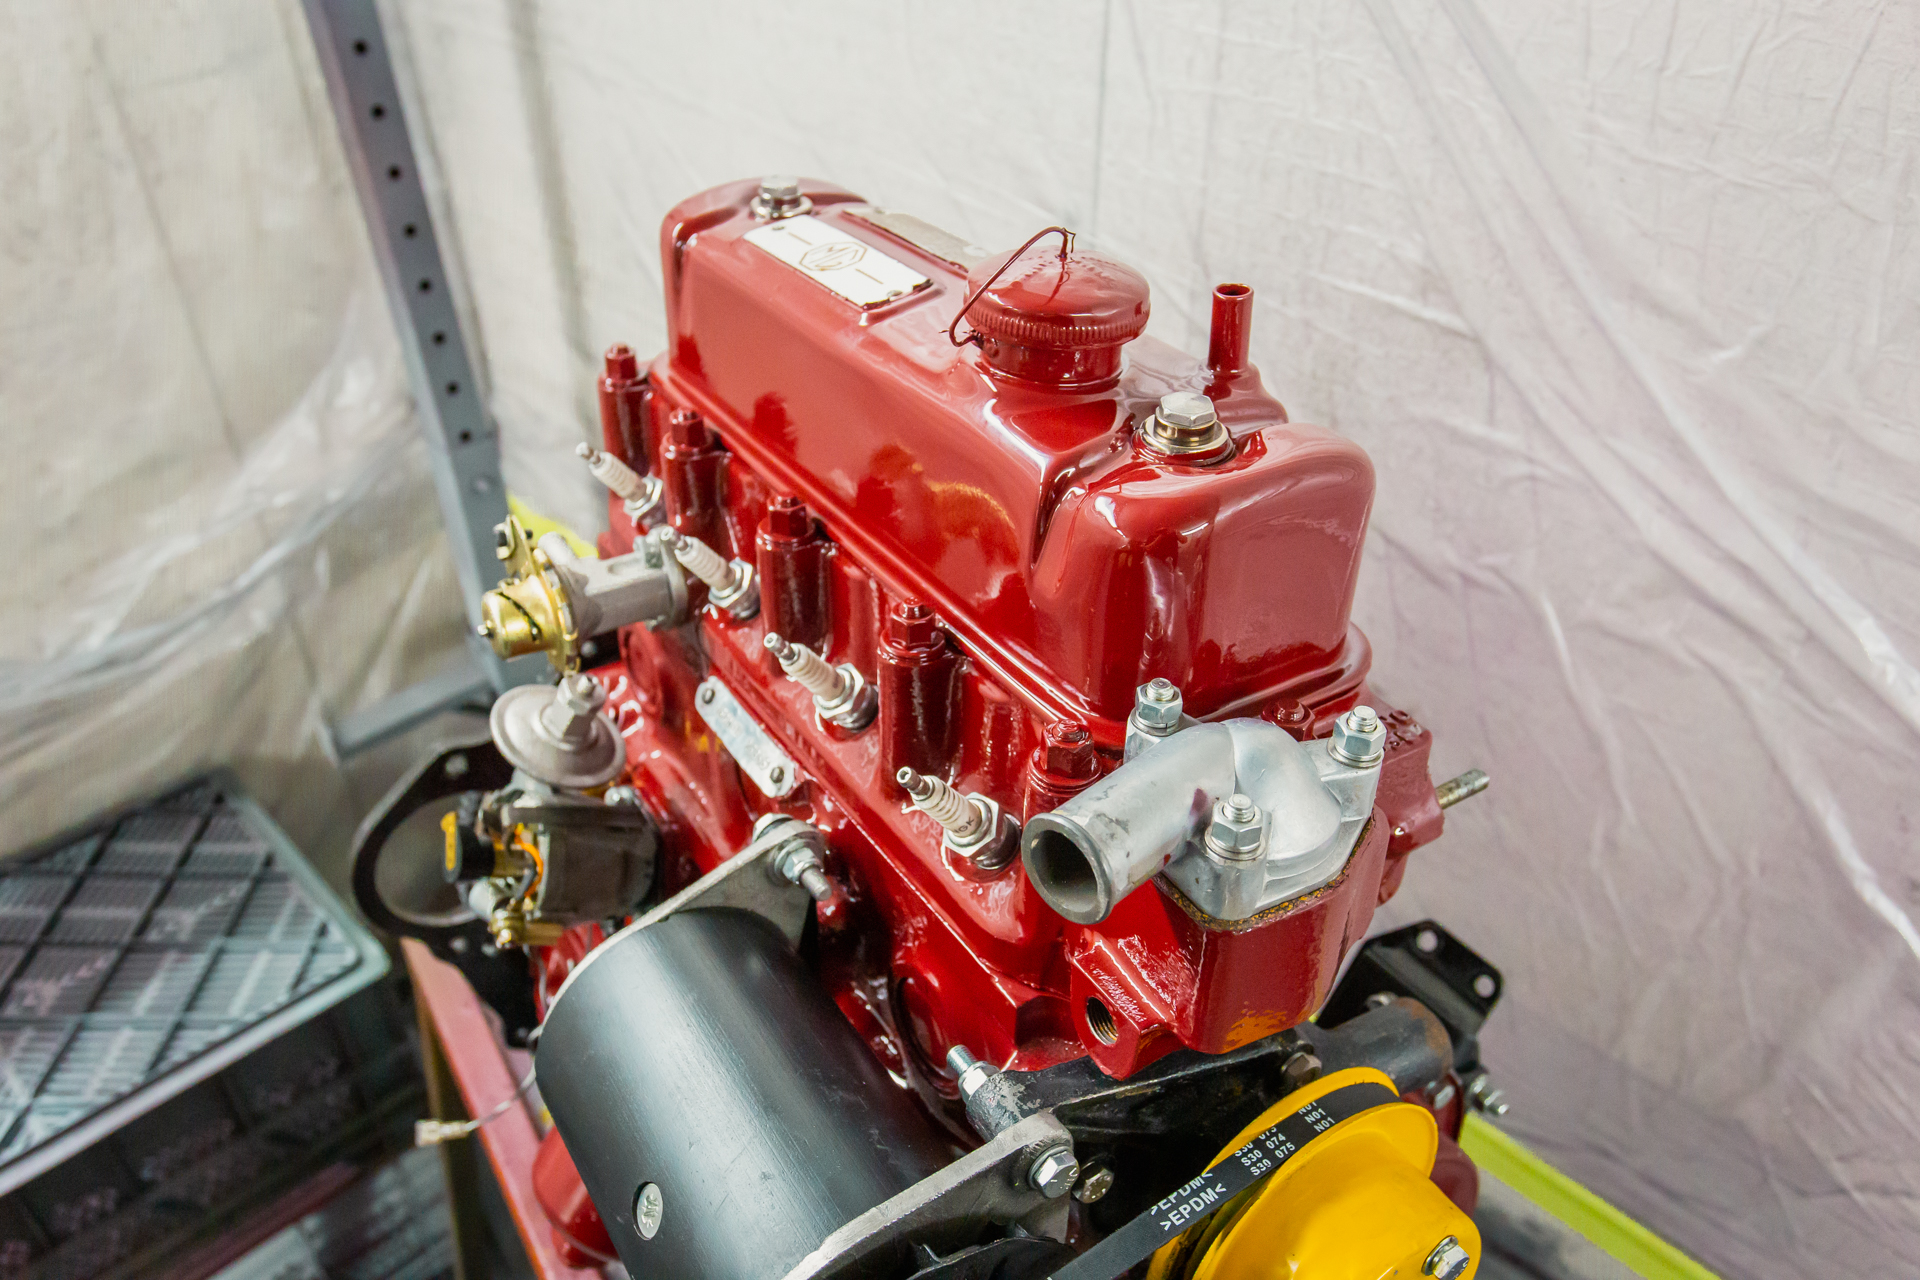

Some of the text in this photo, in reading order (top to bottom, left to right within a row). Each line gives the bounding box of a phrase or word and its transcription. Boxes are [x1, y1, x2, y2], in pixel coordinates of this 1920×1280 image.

[1240, 1149, 1263, 1166] S30
[1265, 1132, 1287, 1149] 074
[1250, 1158, 1272, 1176] S30
[1274, 1141, 1296, 1158] 075
